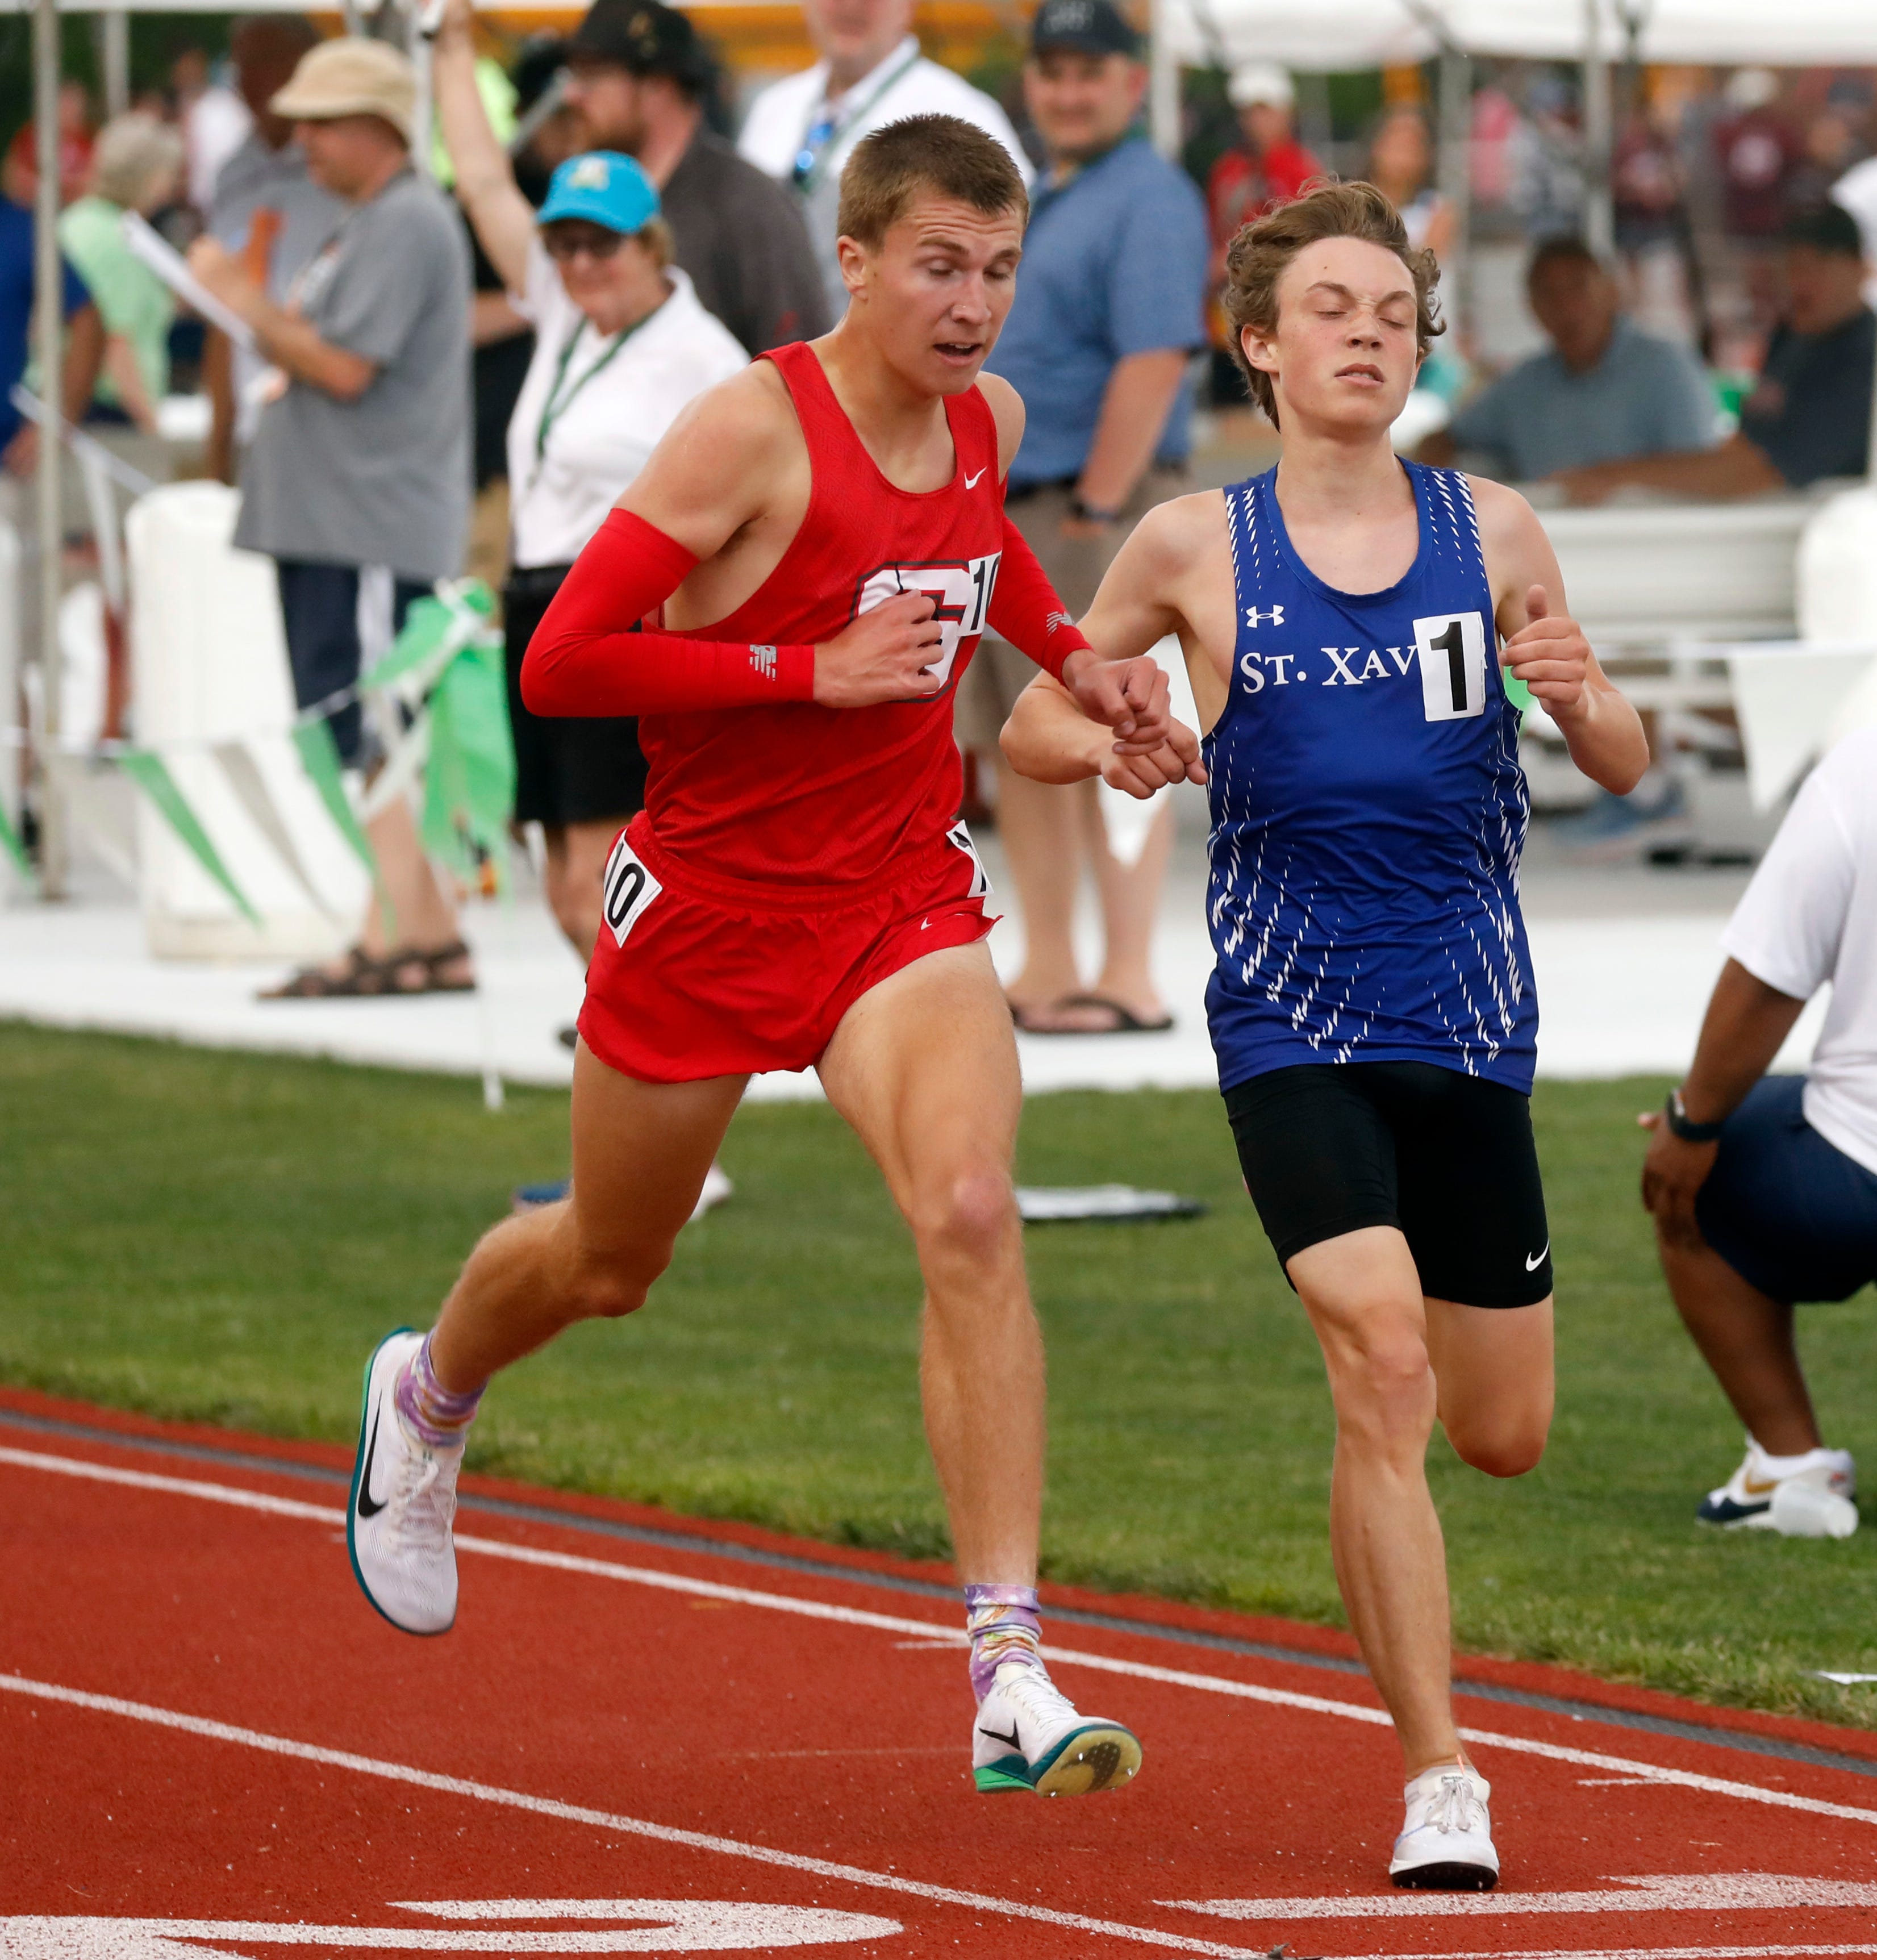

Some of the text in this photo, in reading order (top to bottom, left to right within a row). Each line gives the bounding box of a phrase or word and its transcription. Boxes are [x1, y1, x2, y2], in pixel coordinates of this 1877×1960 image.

[1240, 644, 1419, 694] ST. XAV
[1429, 621, 1467, 712] 1
